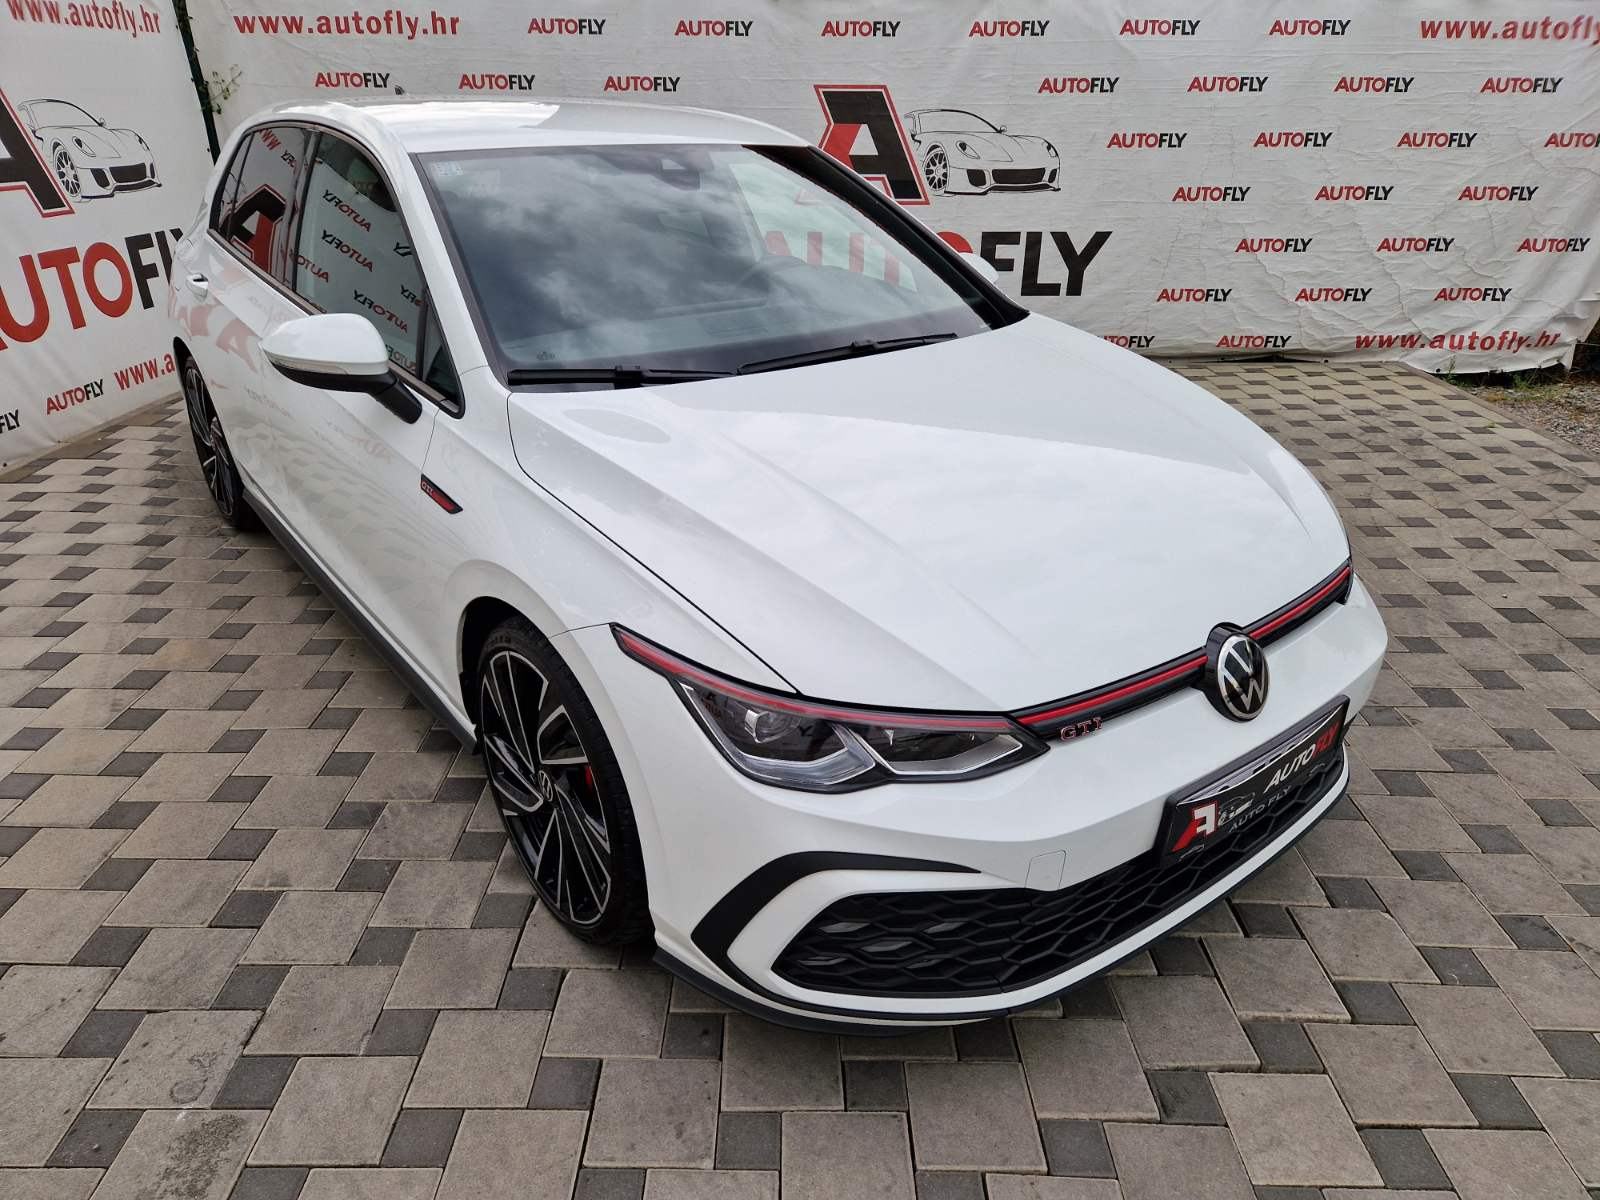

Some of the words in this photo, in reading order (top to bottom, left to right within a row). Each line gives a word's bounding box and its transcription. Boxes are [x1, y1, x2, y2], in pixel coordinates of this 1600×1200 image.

[6, 0, 161, 38] www.autofly.hr
[234, 9, 461, 41] www.autofly.hr
[528, 18, 605, 35] AUTOFLY
[1269, 19, 1351, 36] AUTOFLY
[674, 19, 753, 37] AUTOFLY
[822, 19, 900, 37] AUTOFLY
[969, 19, 1050, 37] AUTOFLY
[1120, 20, 1200, 36] AUTOFLY
[314, 72, 391, 89] AUTOFLY
[459, 74, 535, 91] AUTOFLY
[604, 76, 681, 92] AUTOFLY
[1039, 77, 1119, 94] AUTOFLY
[1188, 76, 1268, 93] AUTOFLY
[1334, 76, 1414, 93] AUTOFLY
[1481, 77, 1562, 94] AUTOFLY
[1107, 131, 1188, 149] AUTOFLY
[1253, 131, 1333, 148] AUTOFLY
[1397, 131, 1477, 149] AUTOFLY
[1172, 185, 1252, 202] AUTOFLY
[1314, 185, 1395, 202] AUTOFLY
[1458, 185, 1539, 202] AUTOFLY
[1235, 238, 1313, 254] AUTOFLY
[1377, 238, 1455, 253] AUTOFLY
[1517, 238, 1590, 253] AUTOFLY
[1157, 288, 1233, 303] AUTOFLY
[1295, 288, 1373, 303] AUTOFLY
[1434, 288, 1512, 302] AUTOFLY
[1216, 336, 1293, 350] AUTOFLY
[1354, 330, 1562, 354] www.autofly.hr
[46, 379, 104, 415] AUTOFLY
[1060, 716, 1103, 741] GTI
